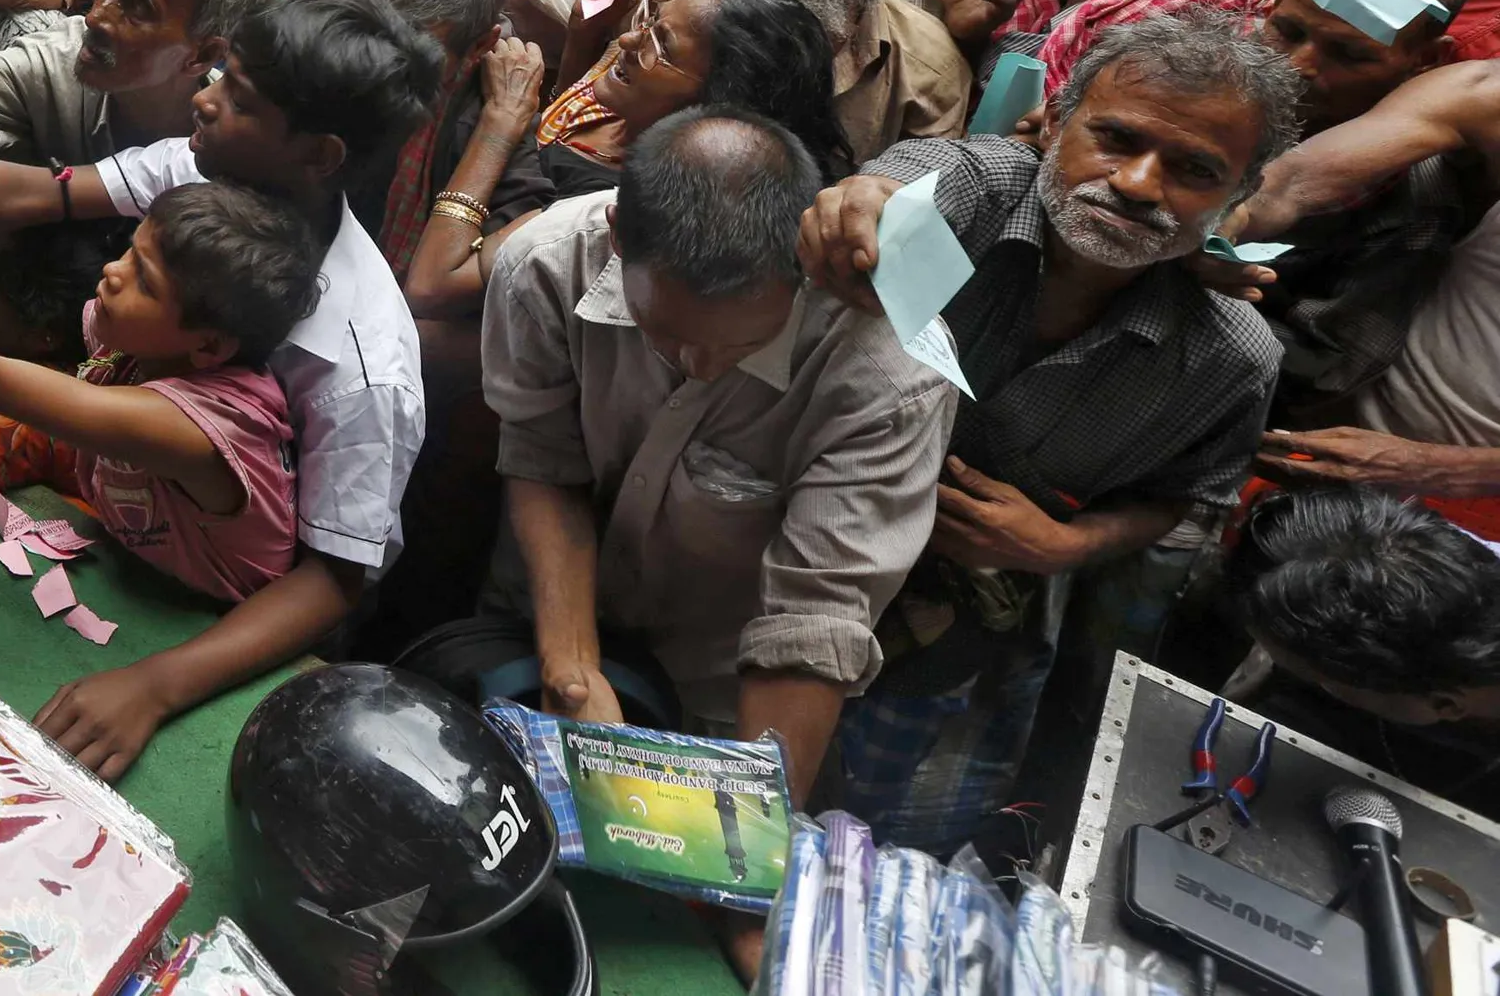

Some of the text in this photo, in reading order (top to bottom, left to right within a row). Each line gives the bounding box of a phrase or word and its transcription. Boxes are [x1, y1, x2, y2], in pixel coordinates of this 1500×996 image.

[578, 753, 766, 795] SUDIP BANDOPADHYAY (M.P.)
[616, 744, 722, 773] BANDOPADHYAY
[725, 760, 773, 775] NAINA
[605, 822, 685, 855] Eid Mubarak
[1171, 872, 1327, 956] SHURE
